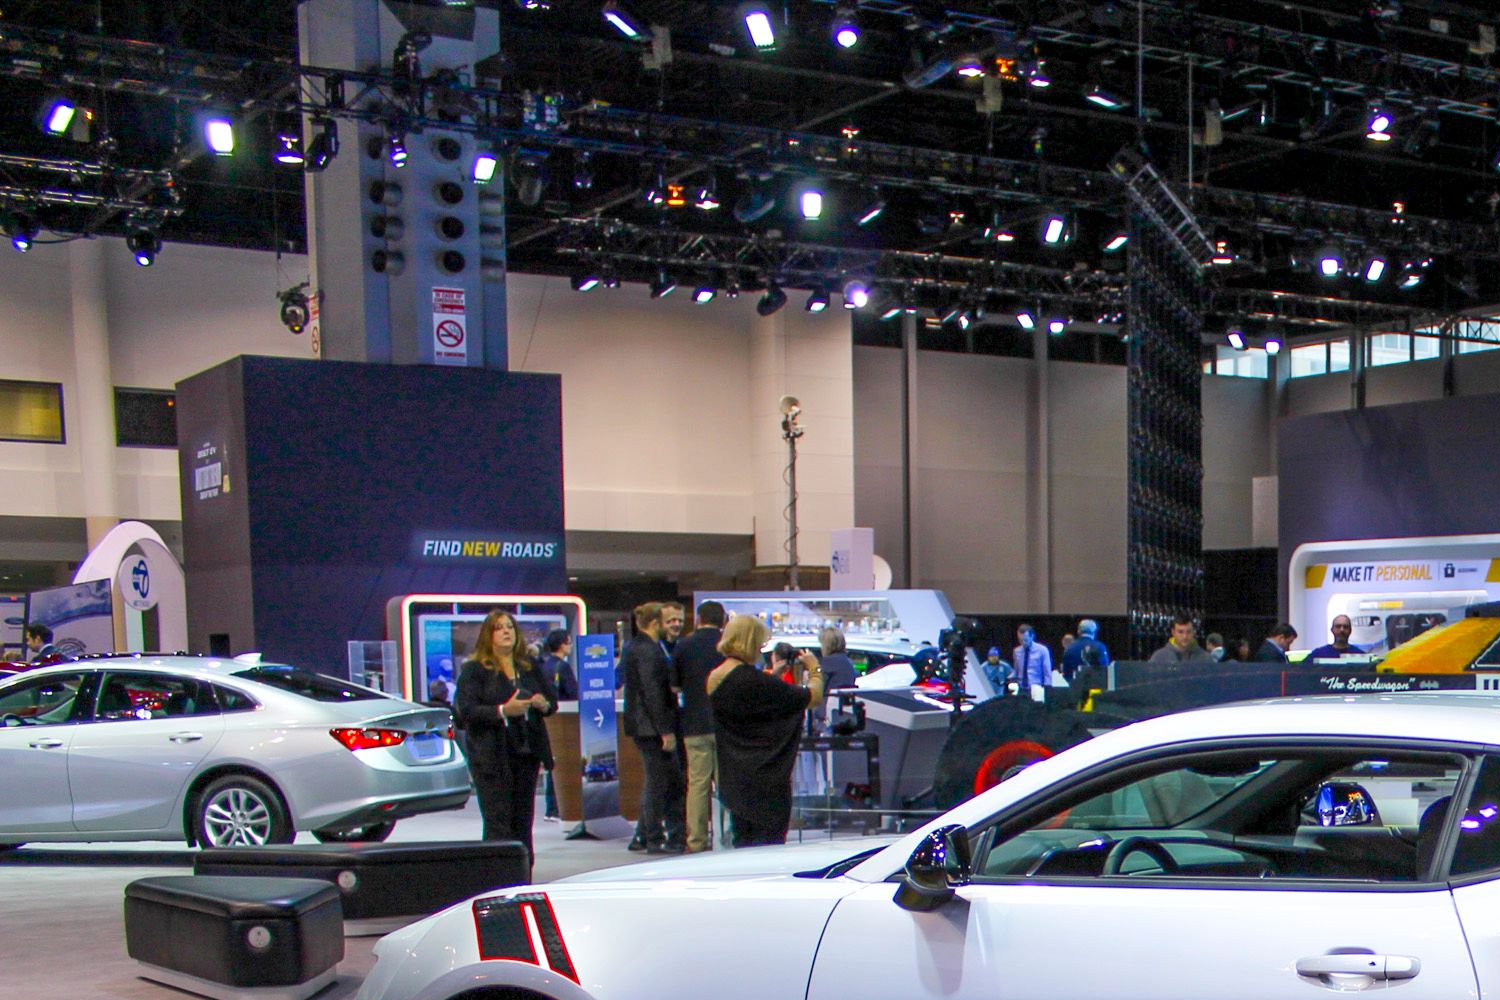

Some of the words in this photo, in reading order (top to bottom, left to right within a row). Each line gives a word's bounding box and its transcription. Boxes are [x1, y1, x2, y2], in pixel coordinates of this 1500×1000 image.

[423, 540, 462, 556] FIND
[462, 541, 501, 557] NEW
[501, 542, 555, 558] ROADS
[1332, 566, 1362, 582] MAKE
[1363, 565, 1375, 581] IT
[1375, 564, 1433, 581] PERSONAL
